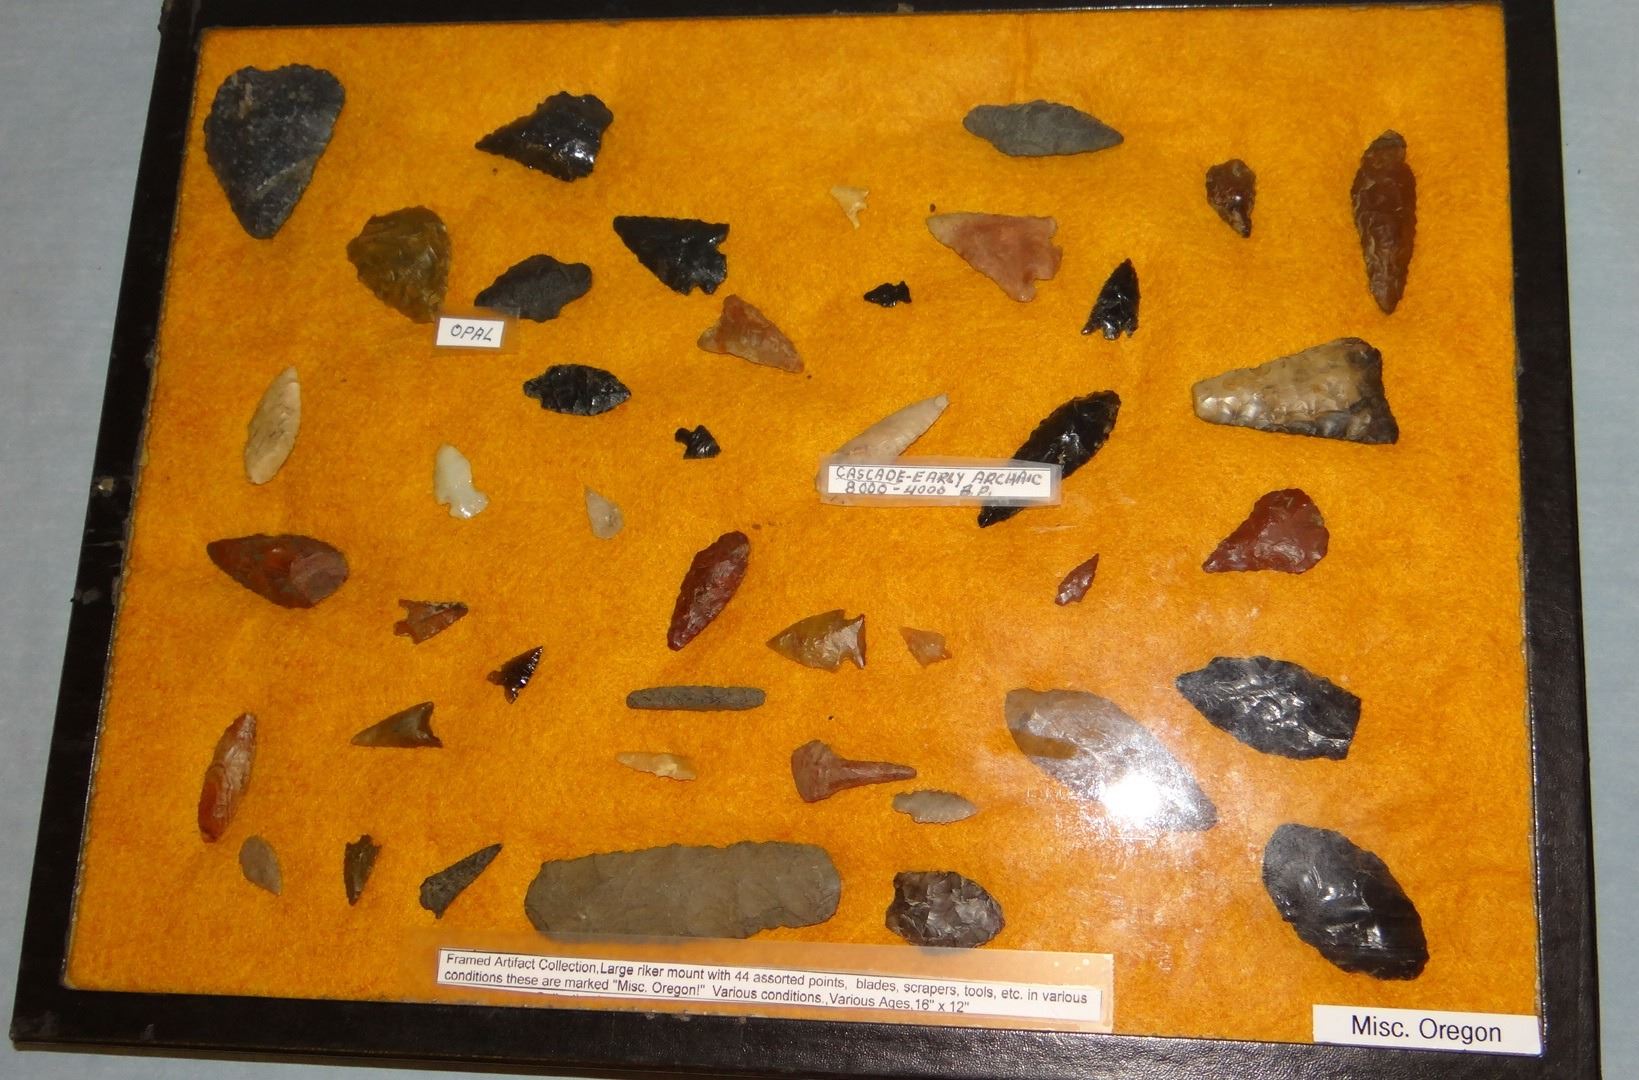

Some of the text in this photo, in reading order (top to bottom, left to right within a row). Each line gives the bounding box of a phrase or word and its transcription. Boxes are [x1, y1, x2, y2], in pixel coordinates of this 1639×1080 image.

[451, 324, 493, 342] OPAL
[836, 466, 1042, 487] CASCADE-EARLY ARCHAIC
[444, 969, 503, 983] conditions
[506, 973, 539, 986] these
[541, 977, 562, 987] are
[564, 978, 609, 990] marked
[612, 980, 647, 993] "Misc.
[652, 981, 706, 997] Oregon!"
[712, 985, 758, 999] Various
[938, 1002, 945, 1011] x
[950, 1001, 969, 1013] 12"
[446, 953, 491, 967] Framed
[494, 956, 535, 970] Artifact
[637, 964, 665, 977] riker
[667, 968, 705, 980] mount
[707, 968, 731, 981] with
[734, 970, 749, 982] 44
[753, 974, 805, 986] assorted
[808, 976, 848, 990] points,
[856, 978, 899, 993] blades,
[903, 982, 960, 997] scrapers,
[964, 985, 997, 1000] tools,
[1001, 988, 1023, 1000] etc.
[1027, 988, 1038, 1001] in
[1042, 990, 1088, 1004] various
[1351, 1014, 1502, 1044] Misc. Oregon
